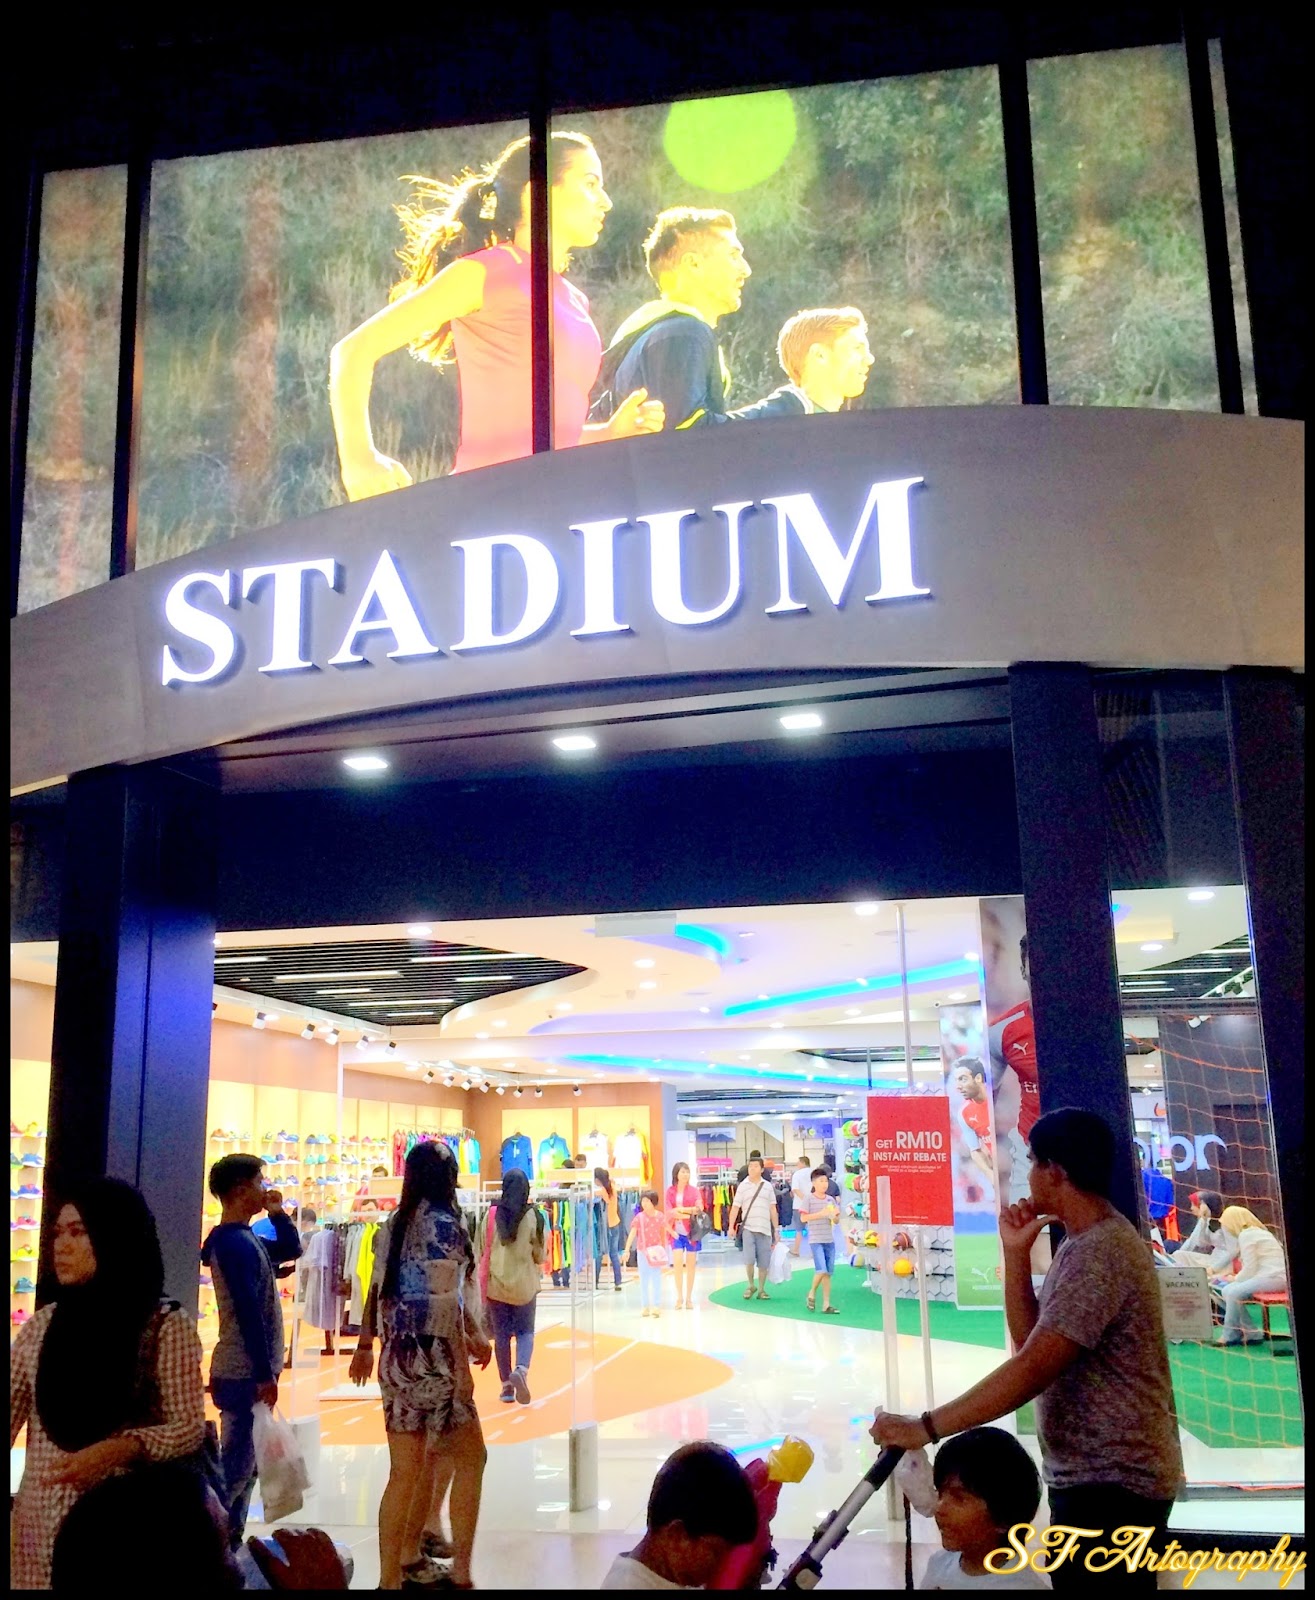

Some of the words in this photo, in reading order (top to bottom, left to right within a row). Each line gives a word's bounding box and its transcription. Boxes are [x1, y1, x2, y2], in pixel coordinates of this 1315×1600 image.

[162, 476, 932, 687] STADIUM
[875, 1138, 894, 1149] GET
[896, 1131, 943, 1150] RM10
[873, 1151, 911, 1162] INSTANT
[913, 1152, 947, 1162] REBATE
